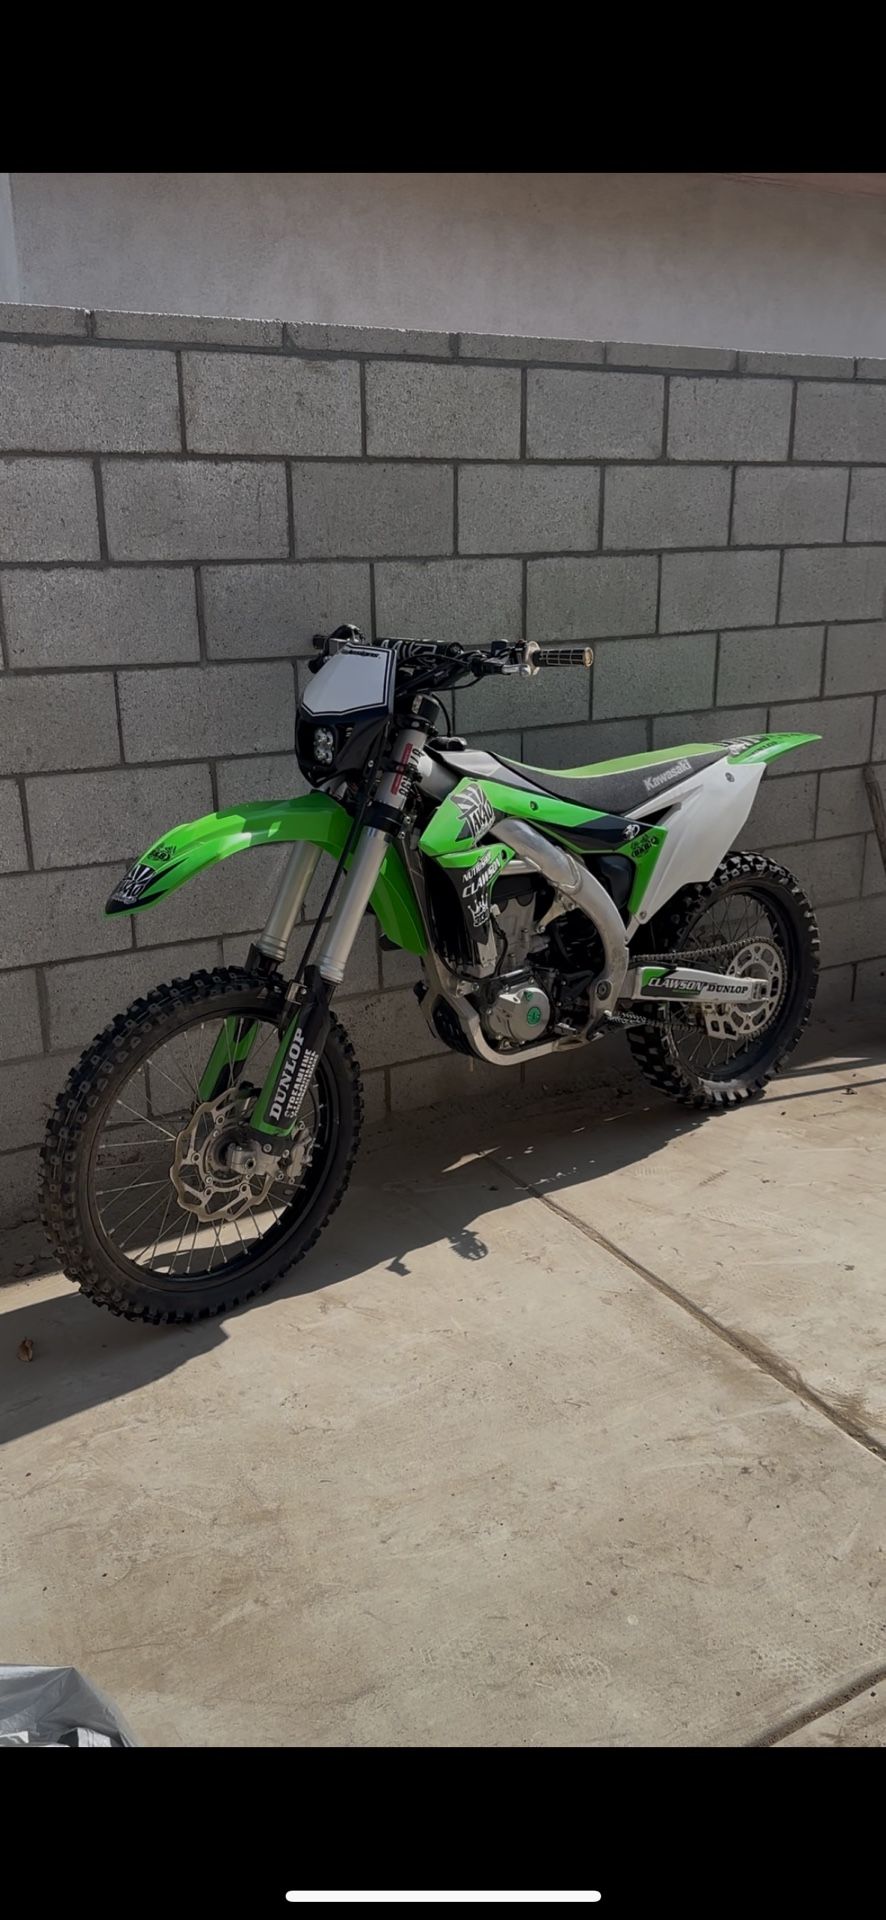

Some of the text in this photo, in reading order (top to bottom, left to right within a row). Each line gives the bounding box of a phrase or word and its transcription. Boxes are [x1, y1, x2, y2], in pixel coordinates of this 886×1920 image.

[643, 759, 692, 791] Kawasaki
[648, 977, 706, 992] CLAWSON
[706, 984, 749, 994] DUNLOP
[269, 1027, 305, 1120] DUNLOP
